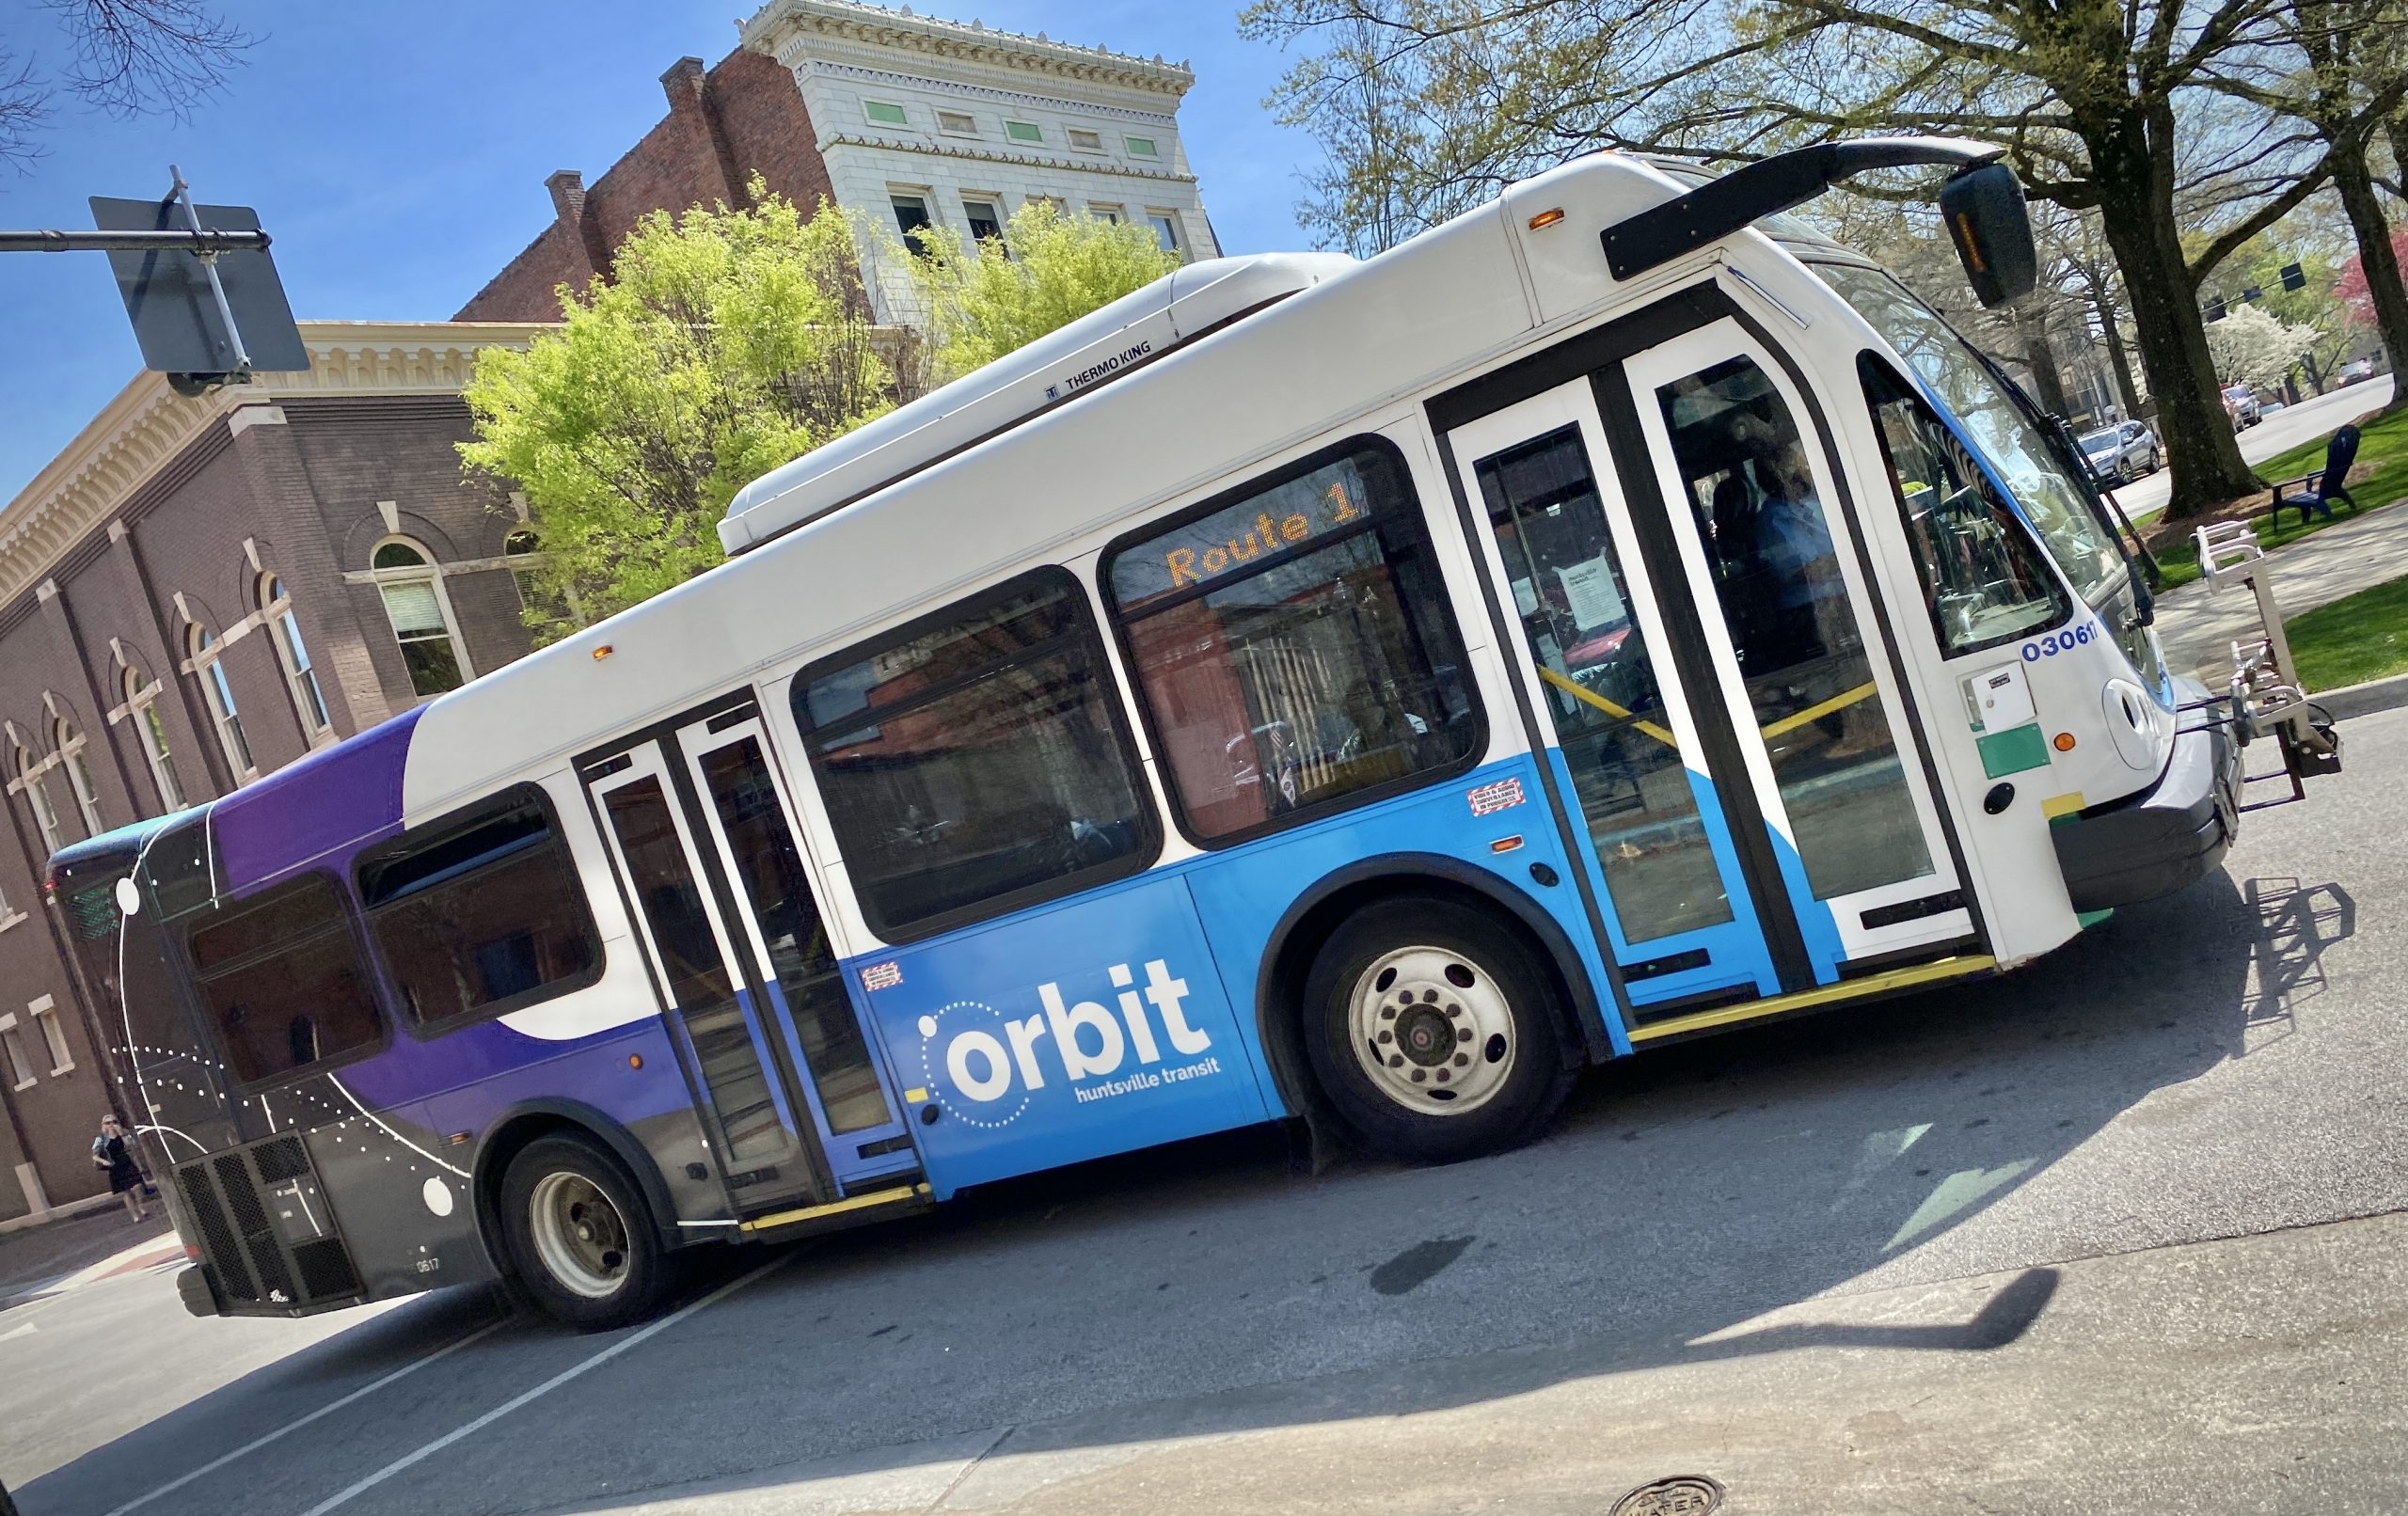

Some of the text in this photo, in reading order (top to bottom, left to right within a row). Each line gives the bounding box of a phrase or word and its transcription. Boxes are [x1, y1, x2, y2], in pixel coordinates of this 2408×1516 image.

[1065, 340, 1151, 390] THERMO KING
[1165, 482, 1359, 587] Route 1
[2021, 620, 2099, 662] 030617
[946, 958, 1212, 1102] orbit
[1074, 1057, 1221, 1104] huntsville transit
